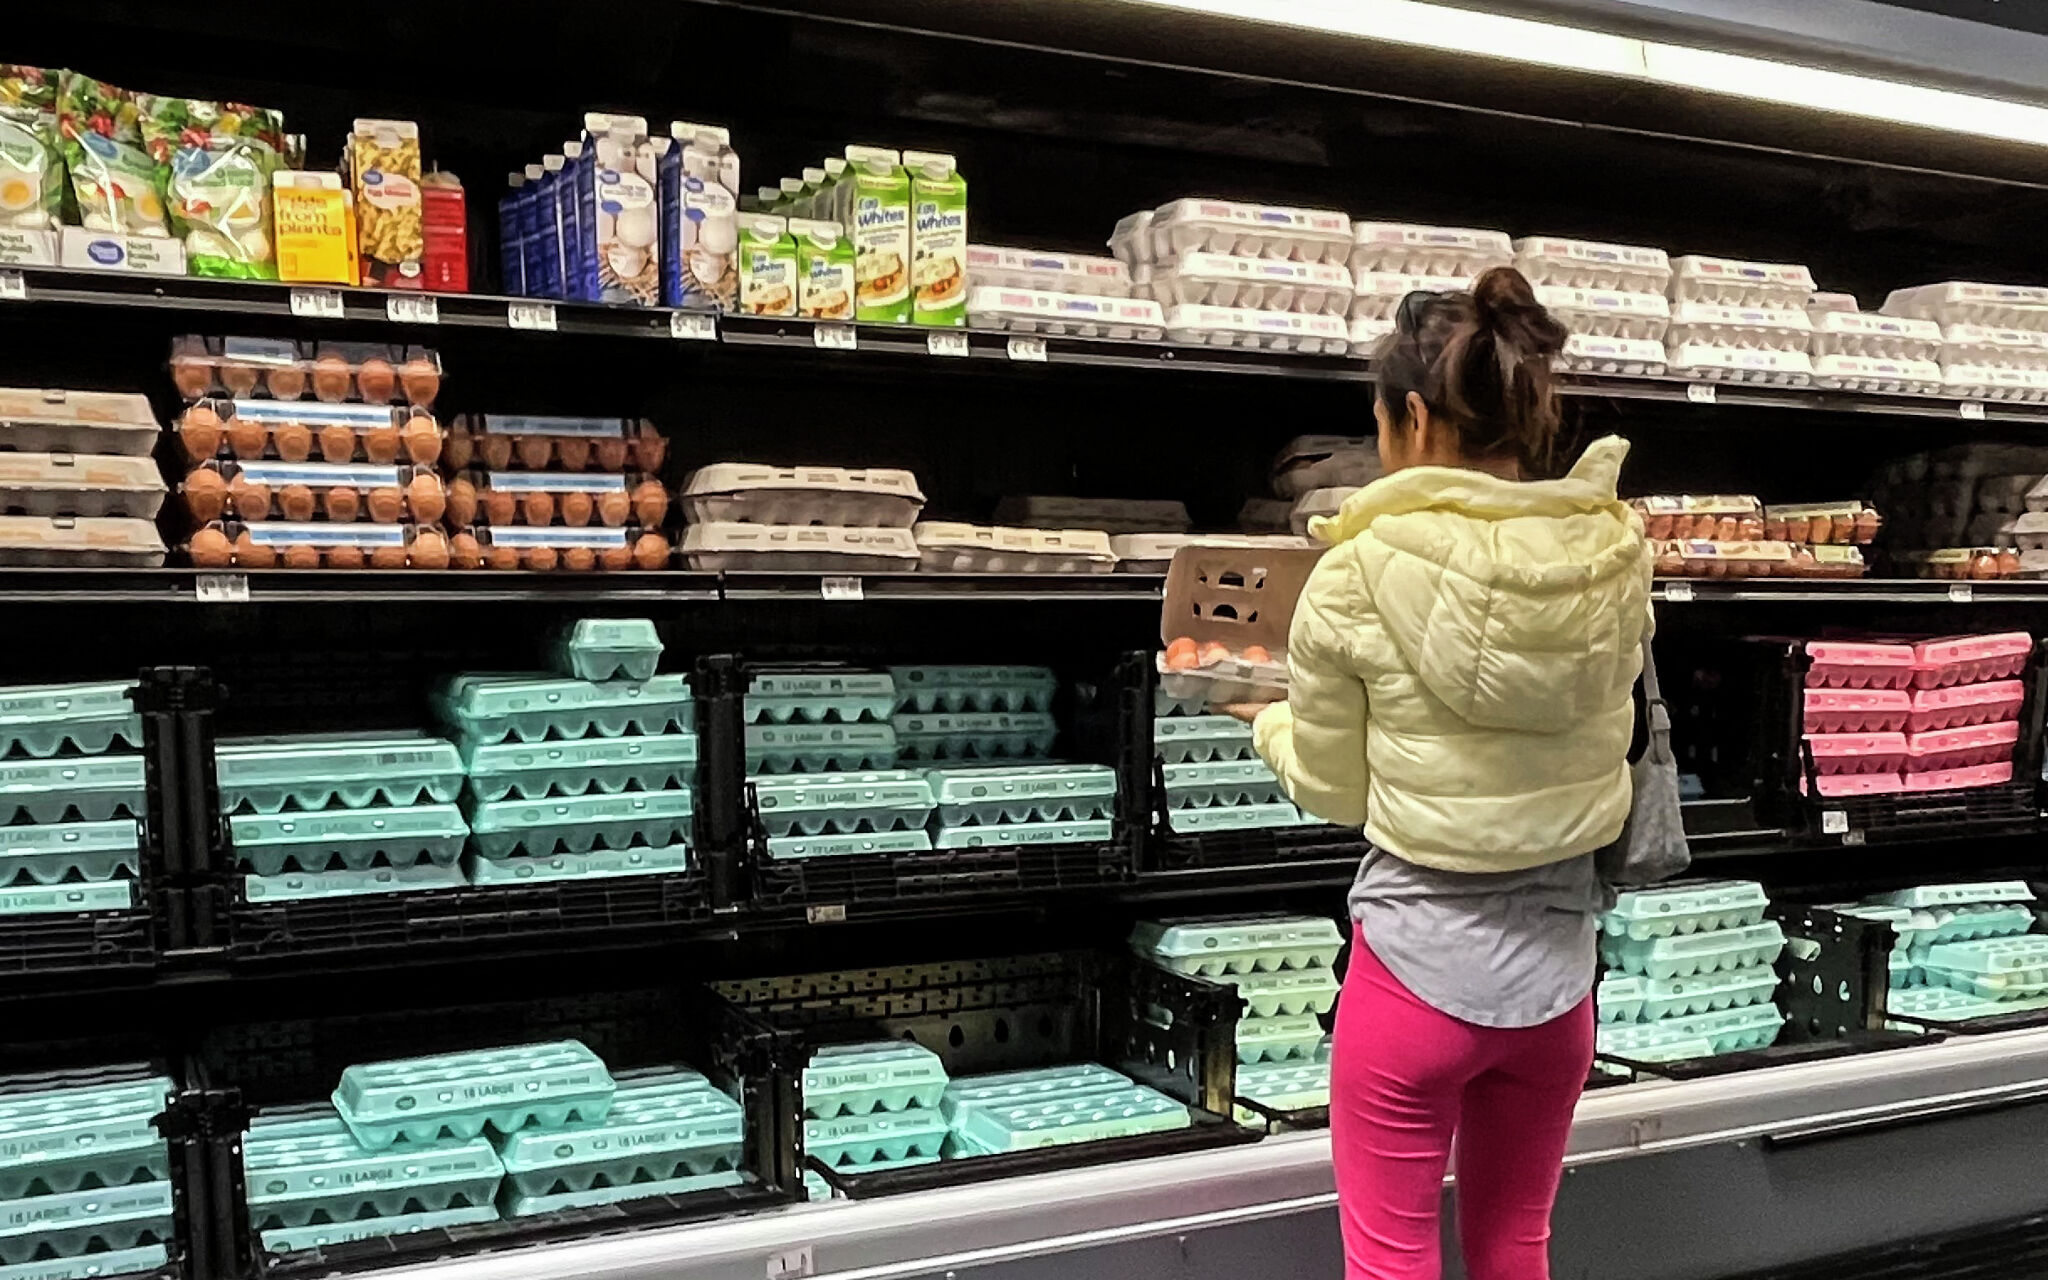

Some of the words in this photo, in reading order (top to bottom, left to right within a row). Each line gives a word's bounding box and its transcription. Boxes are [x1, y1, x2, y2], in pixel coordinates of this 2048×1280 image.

[858, 209, 905, 227] Whites
[916, 214, 961, 231] Whites
[464, 1088, 475, 1100] 18
[479, 1082, 514, 1097] LARGE
[619, 1136, 630, 1148] 18
[632, 1132, 667, 1146] LARGE
[339, 1173, 352, 1184] 18
[355, 1168, 394, 1182] LARGE
